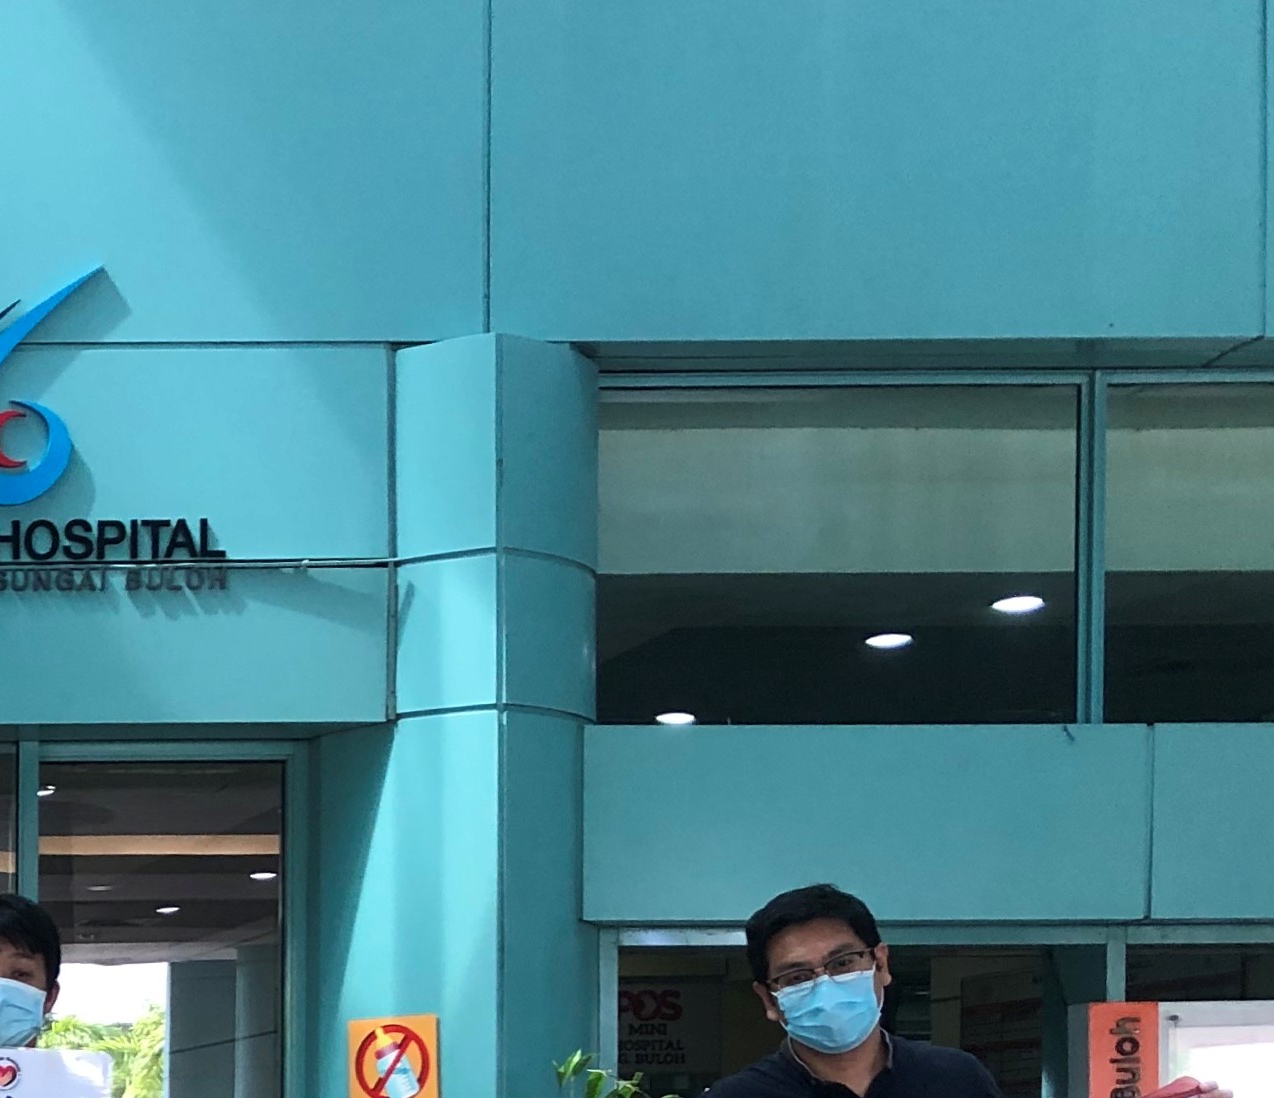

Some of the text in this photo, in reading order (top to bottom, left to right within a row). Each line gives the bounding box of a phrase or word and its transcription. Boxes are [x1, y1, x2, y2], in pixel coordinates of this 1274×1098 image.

[125, 566, 227, 592] BULOH
[628, 1023, 668, 1036] MINI
[619, 1038, 685, 1051] OSPITAL
